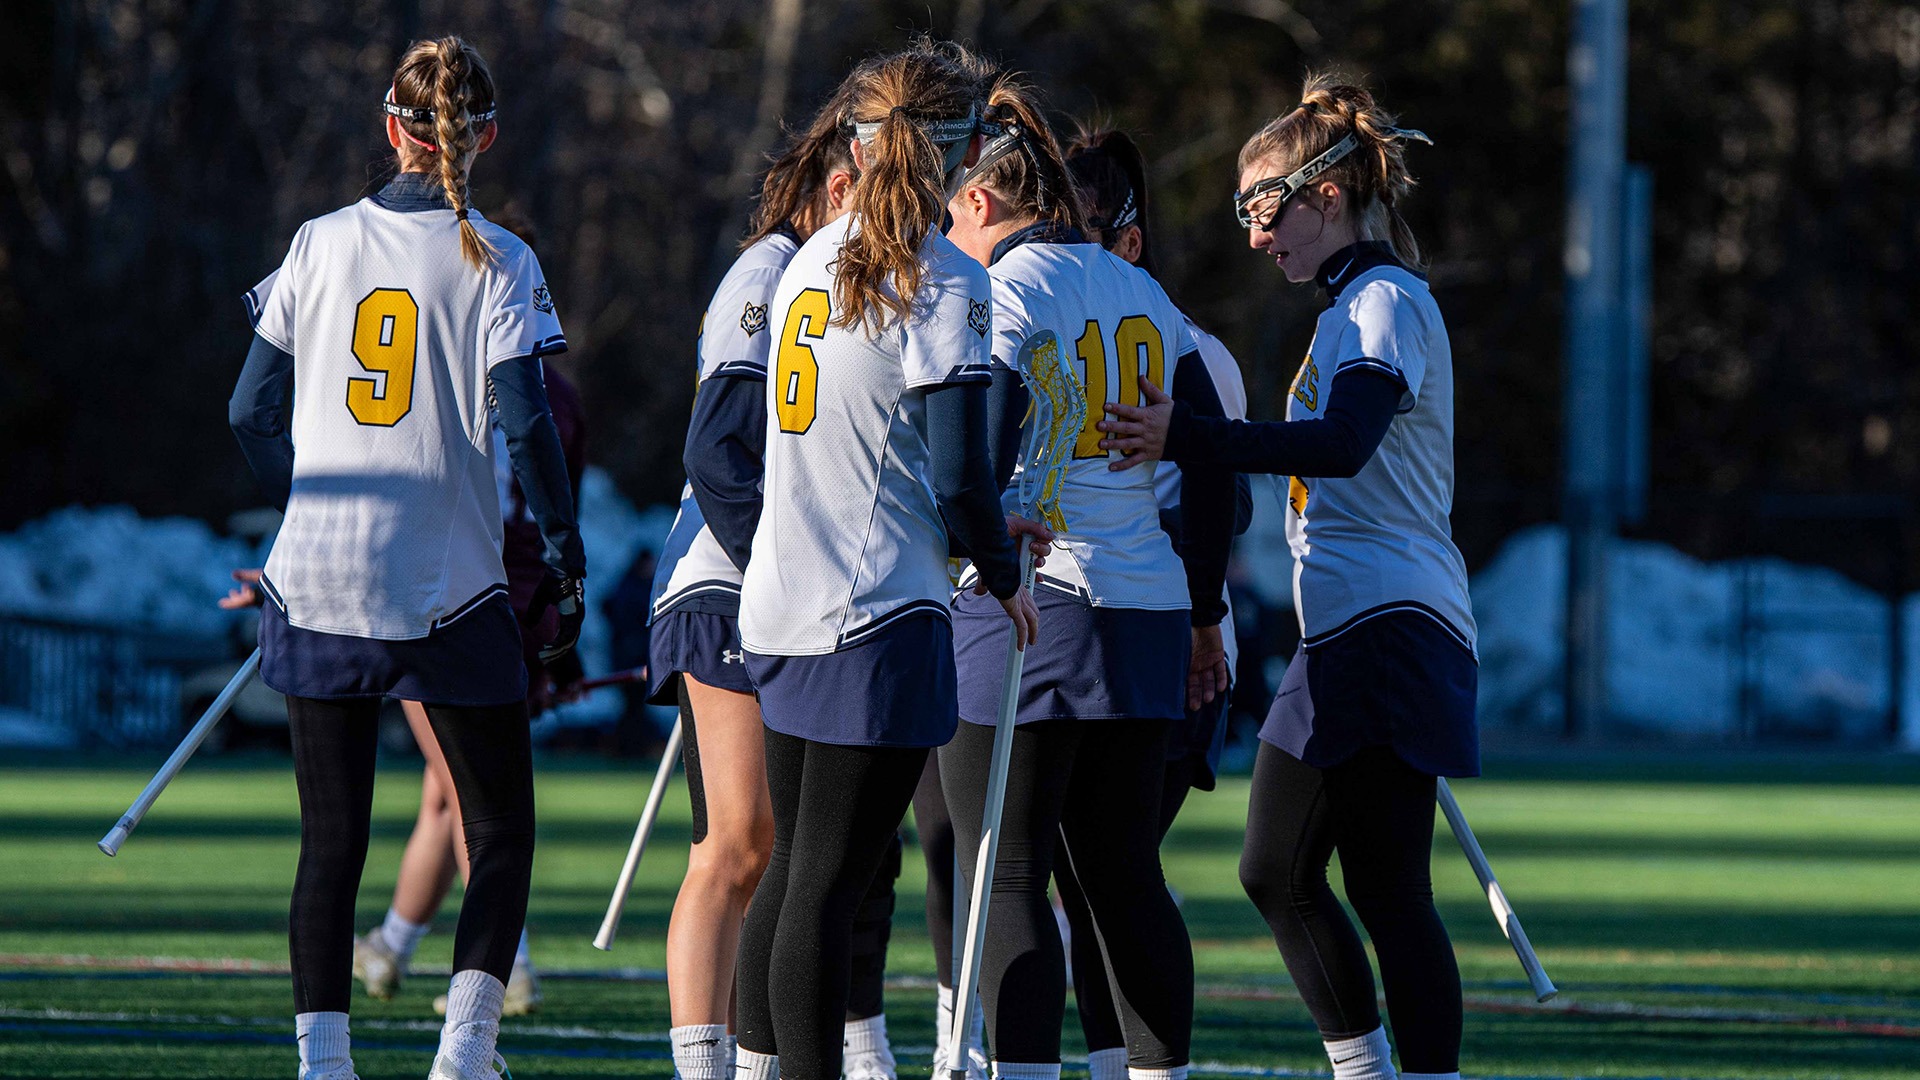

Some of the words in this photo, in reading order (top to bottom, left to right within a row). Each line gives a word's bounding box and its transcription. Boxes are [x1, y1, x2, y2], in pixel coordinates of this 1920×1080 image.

[1303, 156, 1331, 179] STX
[346, 287, 419, 428] 9
[775, 287, 832, 435] 6
[1072, 314, 1165, 460] 10
